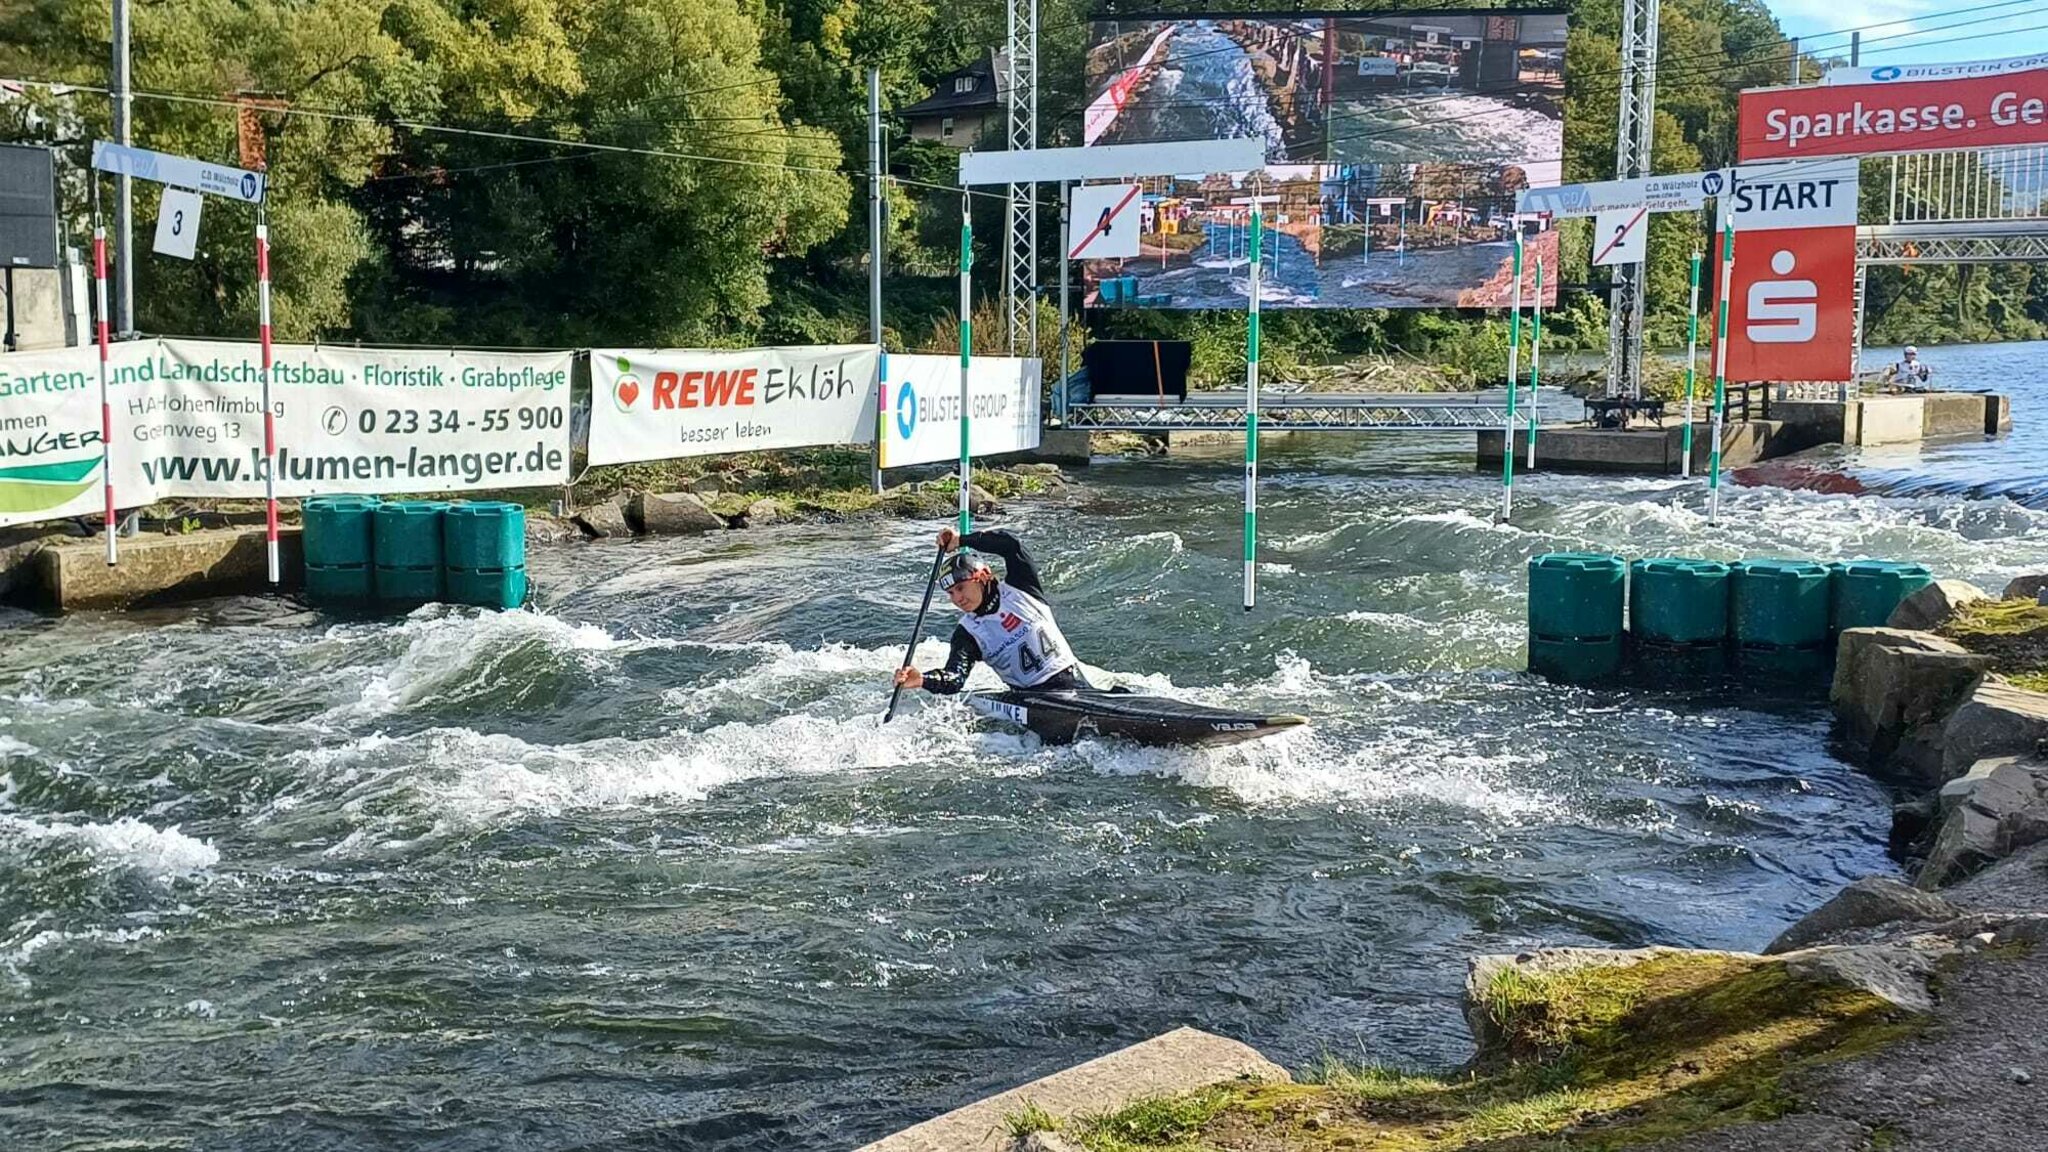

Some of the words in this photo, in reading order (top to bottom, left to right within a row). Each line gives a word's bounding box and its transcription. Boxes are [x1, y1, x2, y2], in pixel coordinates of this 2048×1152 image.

[1906, 63, 2001, 77] BILSTEIN
[1765, 101, 1977, 147] Sparkasse.
[1735, 180, 1839, 213] START
[172, 210, 183, 235] 3
[1097, 207, 1112, 236] 4
[1614, 225, 1625, 247] 2
[0, 371, 95, 396] Garten-
[363, 365, 443, 387] Floristik
[461, 366, 566, 392] Grabpflege
[653, 368, 758, 410] REWE
[764, 359, 854, 404] Eklöh
[358, 409, 376, 433] 0
[384, 409, 419, 434] 23
[427, 409, 460, 433] 34
[481, 408, 510, 432] 55
[518, 406, 563, 430] 900
[919, 396, 971, 422] BILSTE
[973, 394, 1007, 419] GROUP
[0, 431, 105, 456] NGER
[223, 422, 241, 439] 13
[681, 425, 729, 443] besser
[735, 421, 771, 438] leben
[1018, 626, 1060, 675] 44
